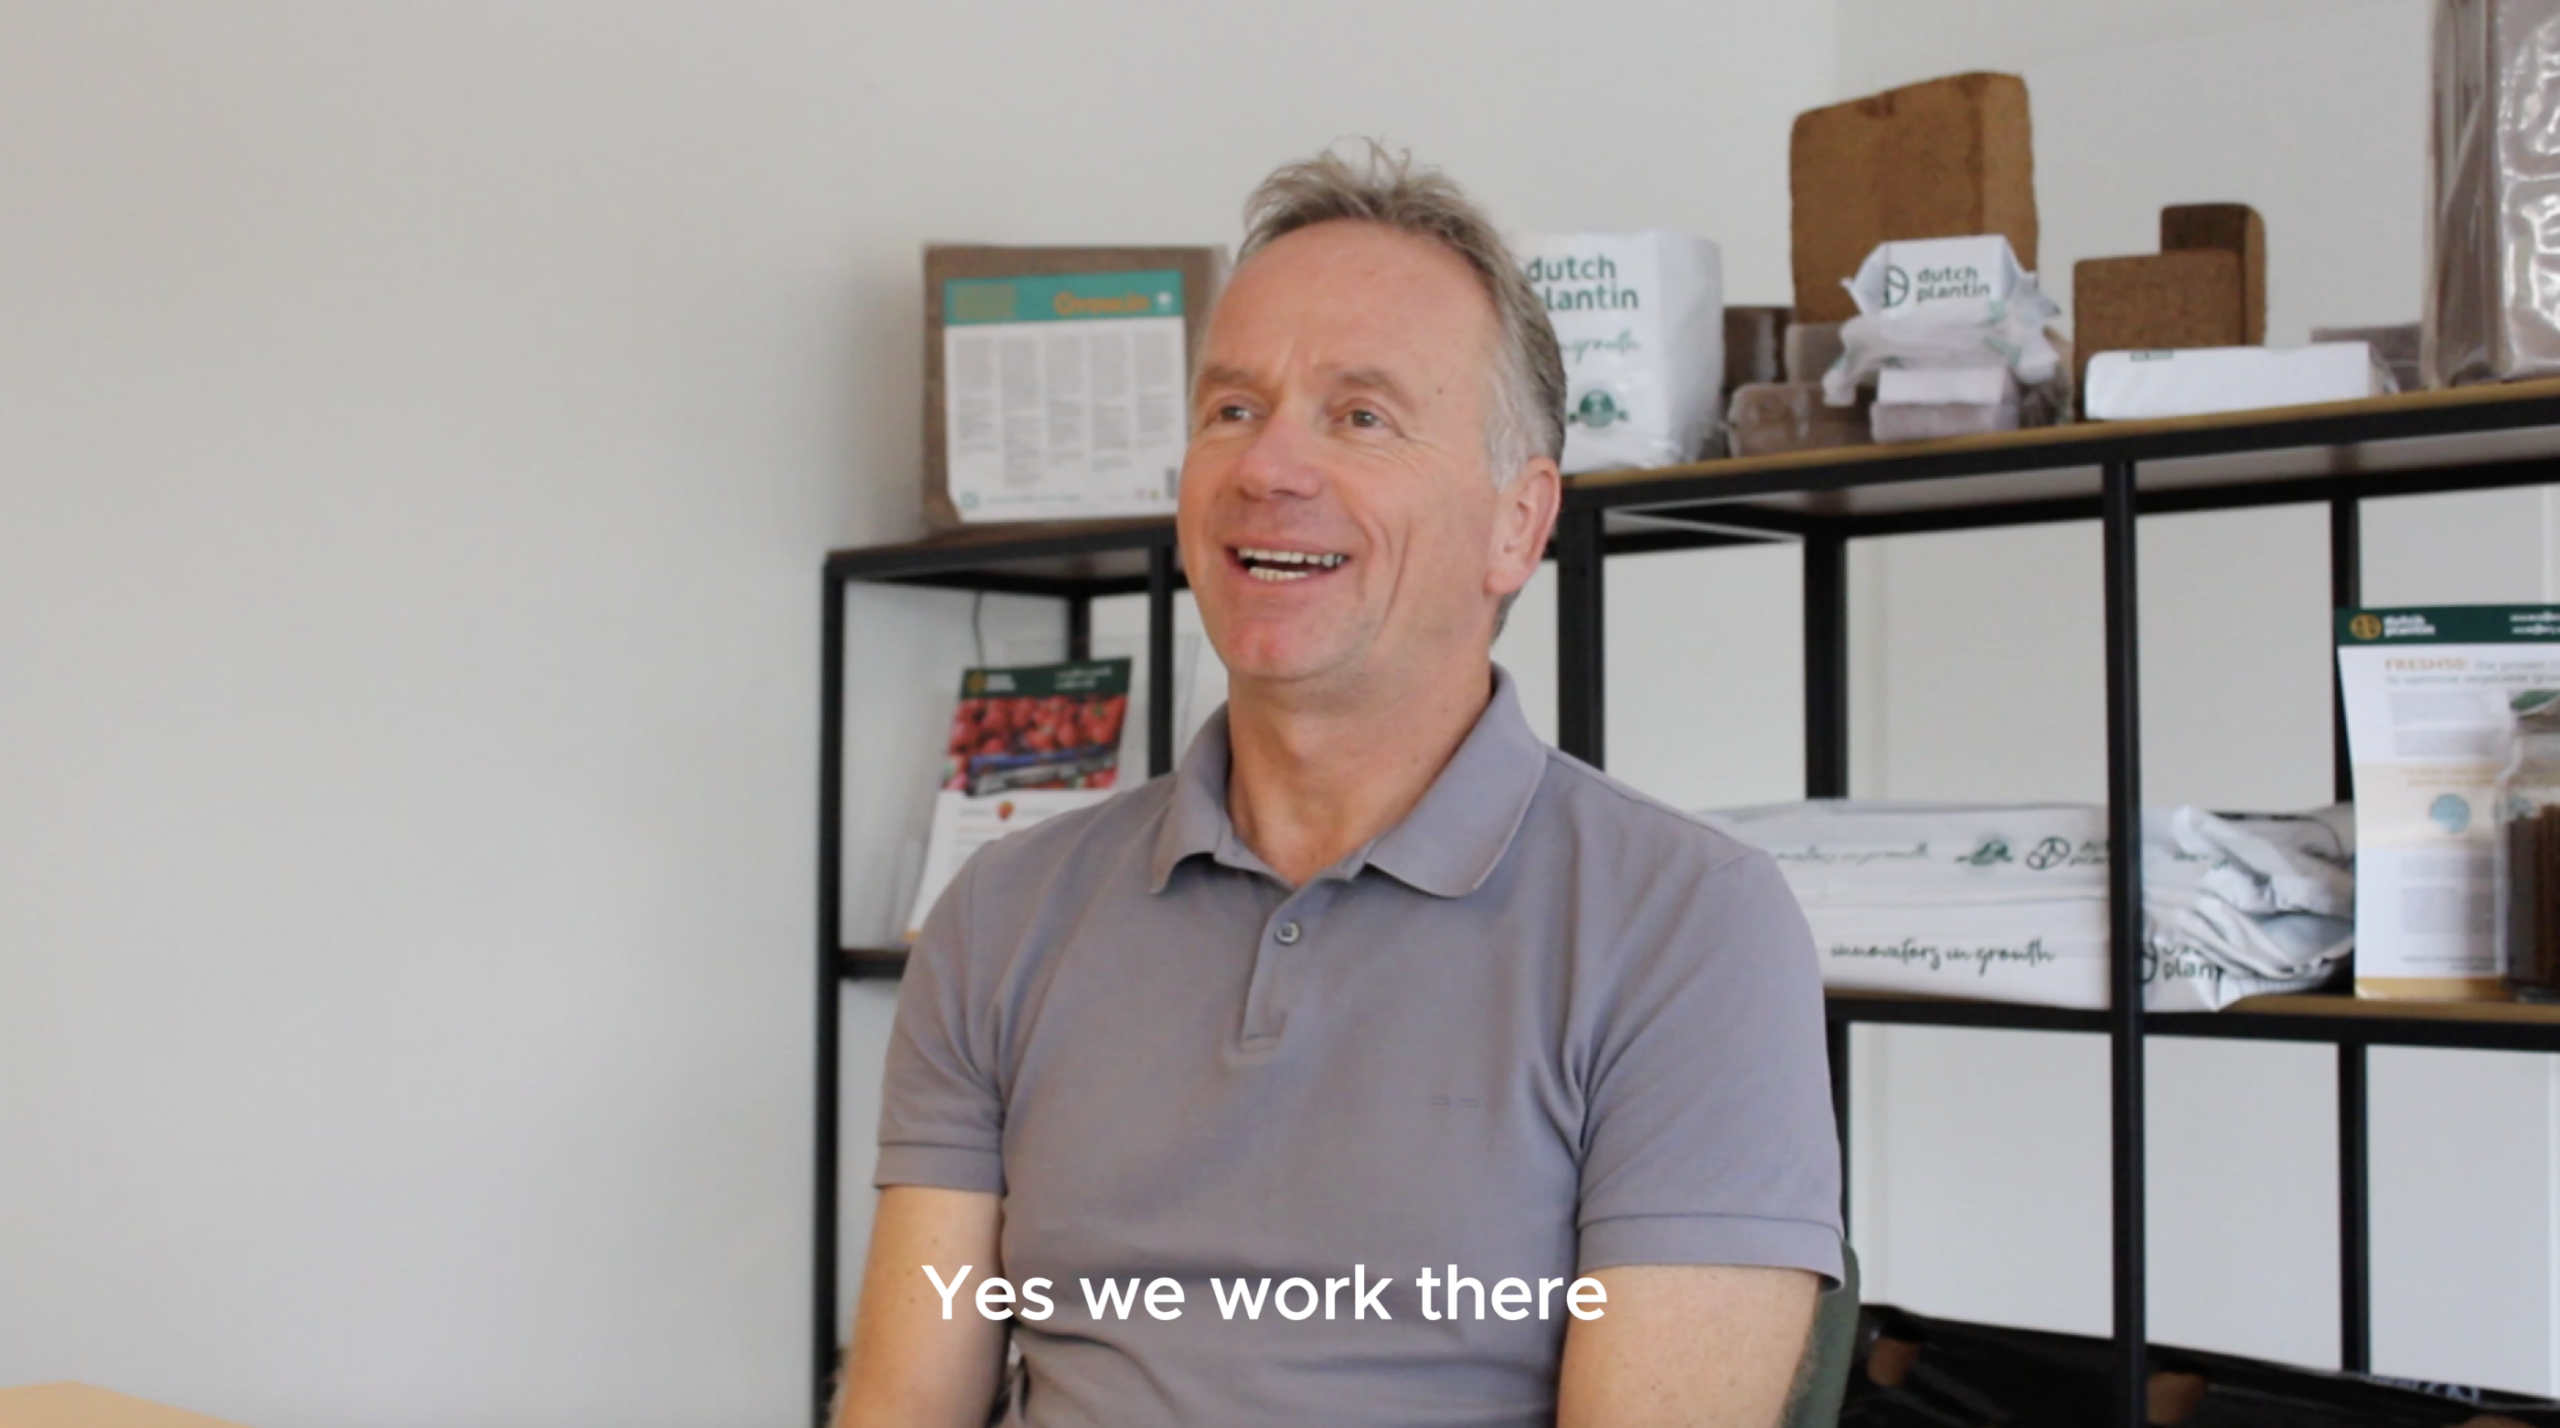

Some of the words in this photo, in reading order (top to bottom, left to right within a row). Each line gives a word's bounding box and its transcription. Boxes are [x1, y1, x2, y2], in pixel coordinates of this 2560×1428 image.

[1527, 254, 1617, 283] dutch
[1917, 265, 1979, 284] dutch
[1545, 283, 1640, 312] lantin
[1917, 281, 1991, 304] plantin
[1974, 937, 2057, 977] growth
